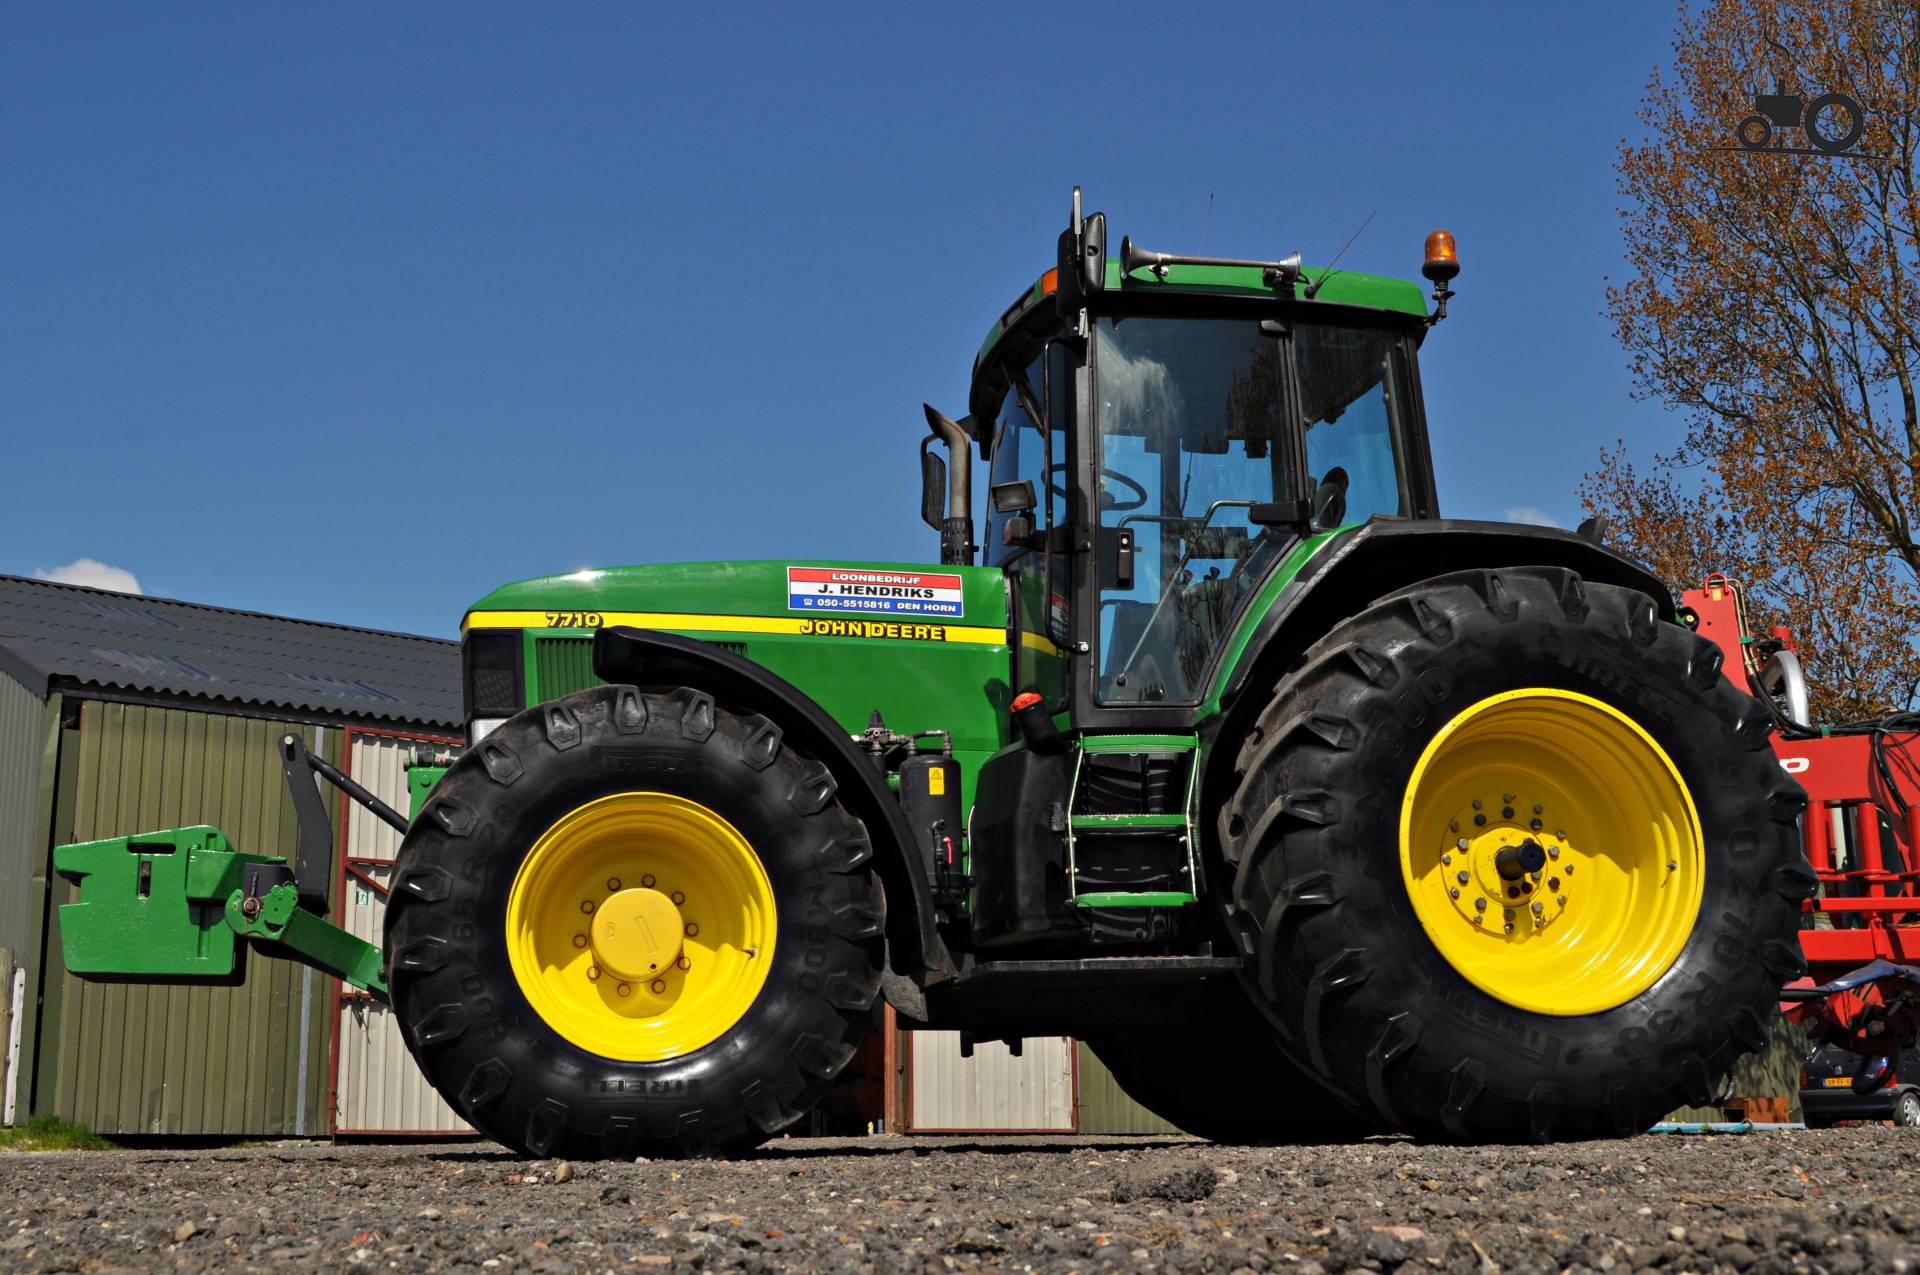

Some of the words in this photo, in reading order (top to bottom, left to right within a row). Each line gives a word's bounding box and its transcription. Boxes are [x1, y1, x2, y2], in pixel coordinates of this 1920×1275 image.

[832, 572, 921, 585] LOONBEDRIJF
[818, 584, 834, 595] J.
[840, 585, 935, 599] HENDRIKS
[817, 598, 891, 610] 050-5515816
[896, 601, 921, 611] DEN
[923, 603, 957, 613] HORN
[546, 612, 604, 628] 7710
[800, 619, 865, 638] JOHN
[869, 622, 947, 642] DEERE
